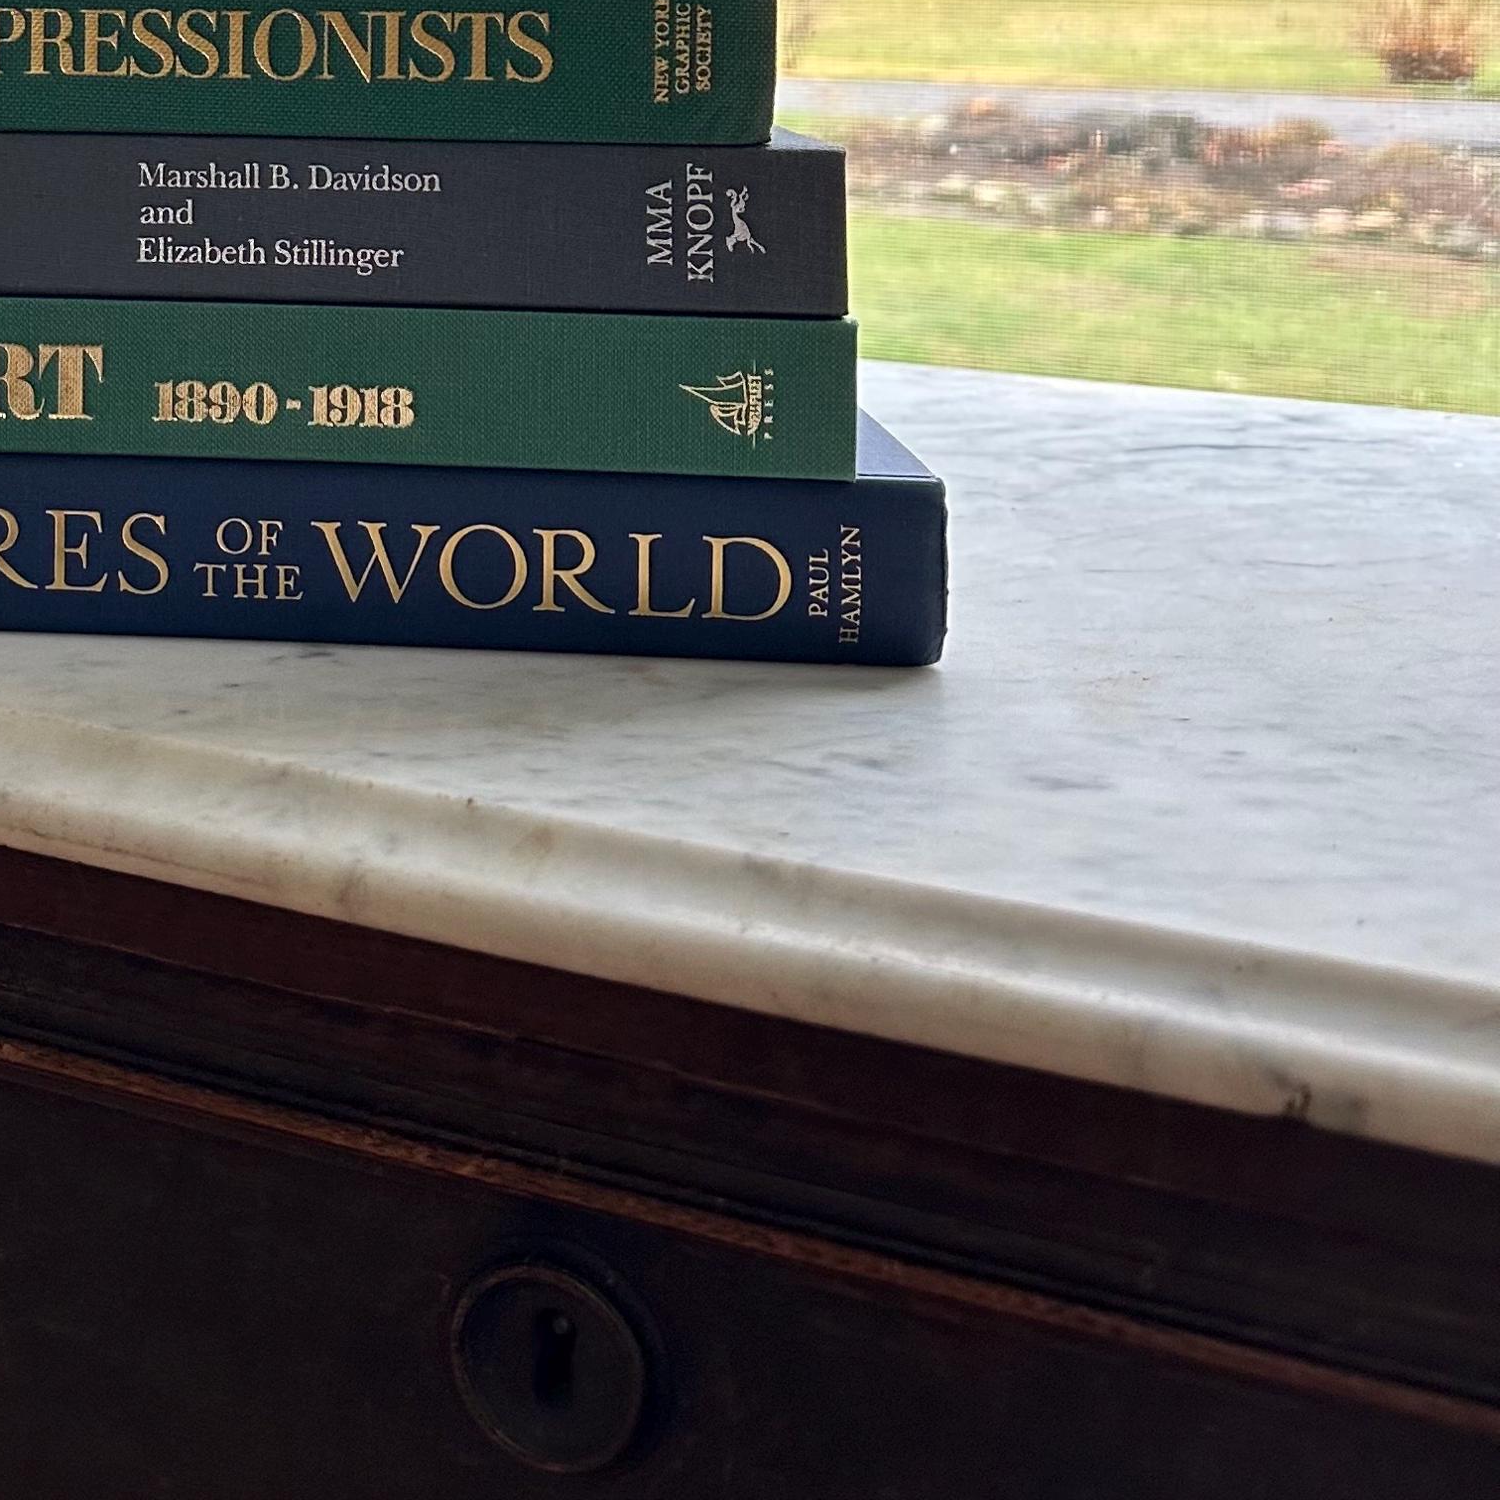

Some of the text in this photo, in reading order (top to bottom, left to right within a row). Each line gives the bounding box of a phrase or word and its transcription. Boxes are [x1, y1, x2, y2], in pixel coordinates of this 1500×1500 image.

[654, 56, 669, 103] NEW
[675, 4, 691, 94] GRAPHIC
[695, 5, 712, 91] SOCIETY
[138, 163, 440, 191] Marshall B. Davidson
[140, 200, 193, 224] and
[646, 180, 673, 265] MMA
[686, 163, 714, 282] KNOPF
[137, 237, 404, 274] Elizabeth Stillinger
[764, 369, 773, 439] PRESS
[216, 518, 283, 555] OF
[311, 521, 791, 620] WORLD
[193, 563, 303, 600] THE
[808, 549, 829, 616] PAUL
[840, 525, 861, 641] HAMLYN
